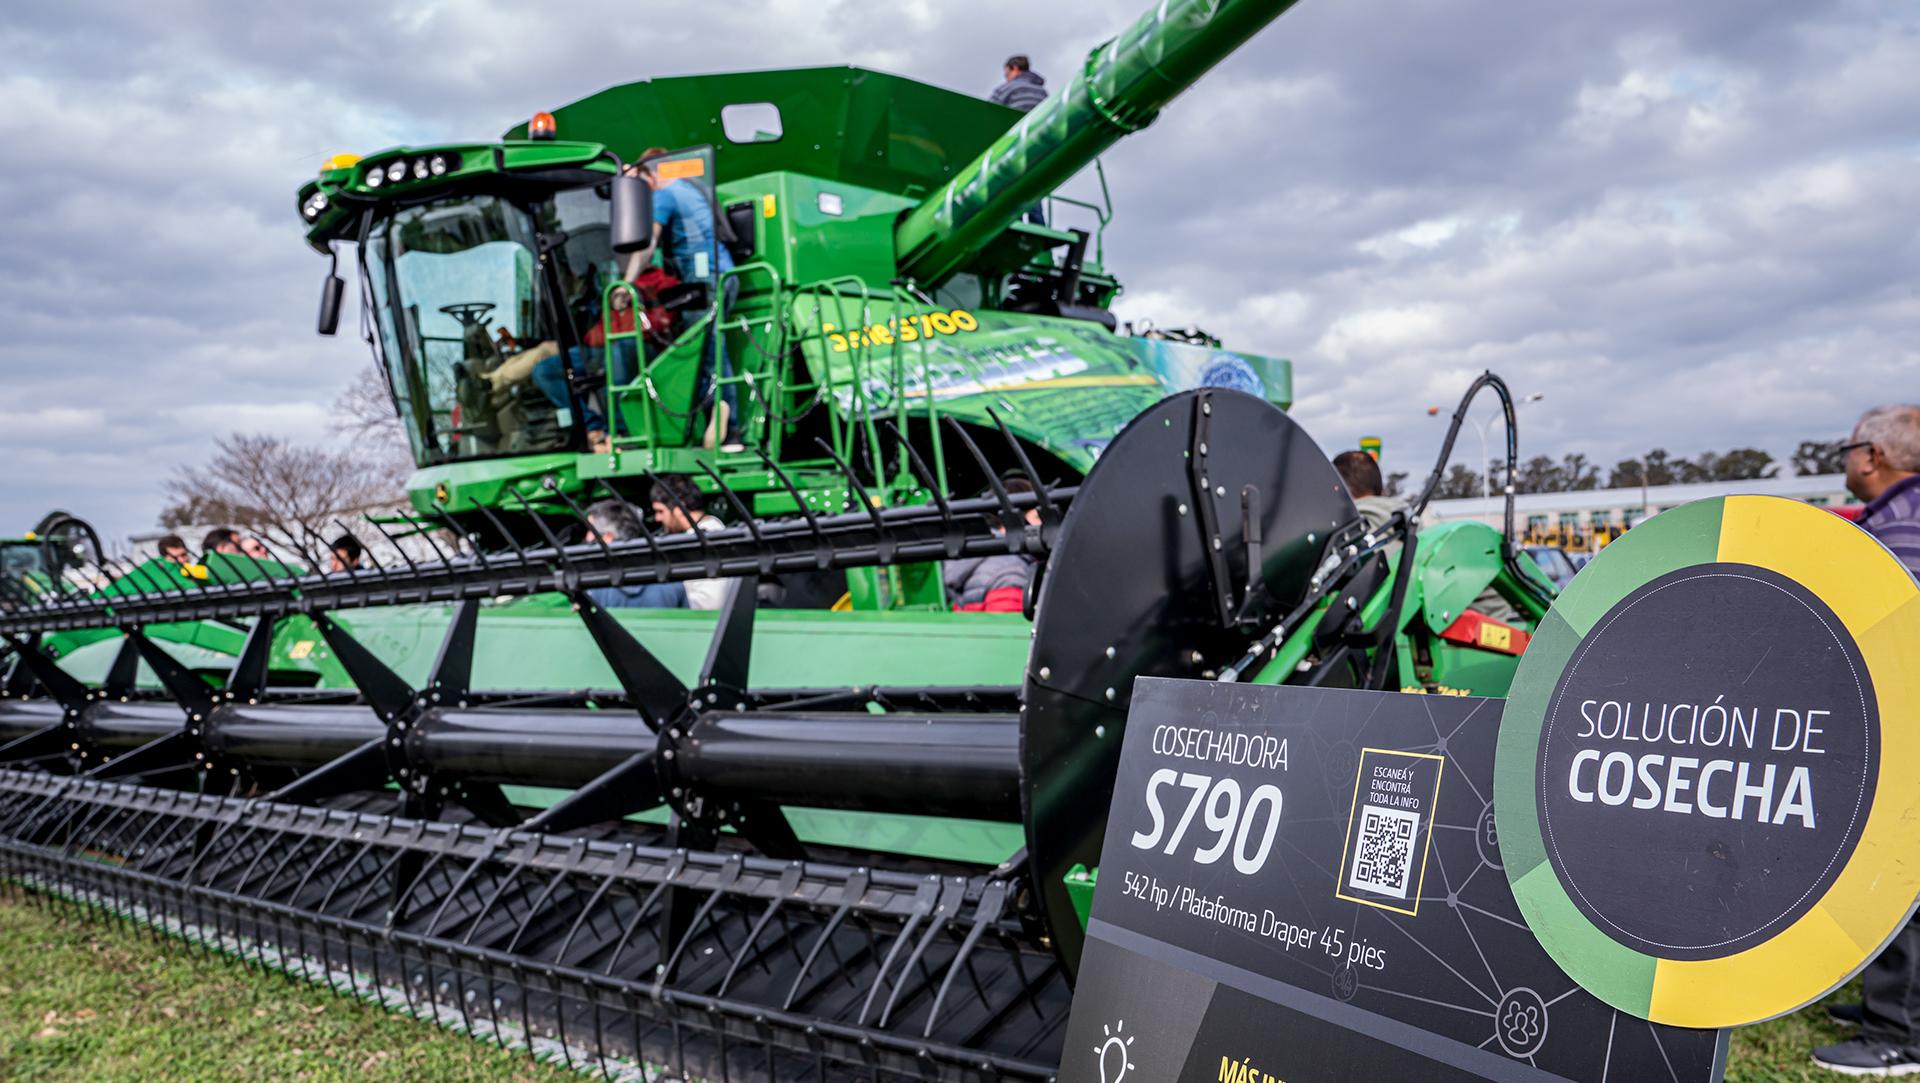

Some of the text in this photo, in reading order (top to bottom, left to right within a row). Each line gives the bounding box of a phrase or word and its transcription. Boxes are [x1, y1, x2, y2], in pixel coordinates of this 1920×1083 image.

[1577, 694, 1831, 754] SOLUCIÓN DE
[1152, 725, 1288, 771] COSECHADORA
[1371, 779, 1411, 794] ENCONTRÁ
[1374, 766, 1414, 781] ESCANEÁ Y
[1568, 749, 1816, 829] COSECHA
[1131, 768, 1283, 875] S790
[1370, 792, 1420, 809] TODA LA INFO
[1122, 871, 1387, 970] 542 hp / Plataforma Draper 45 pies
[1218, 1055, 1260, 1083] MÁS
